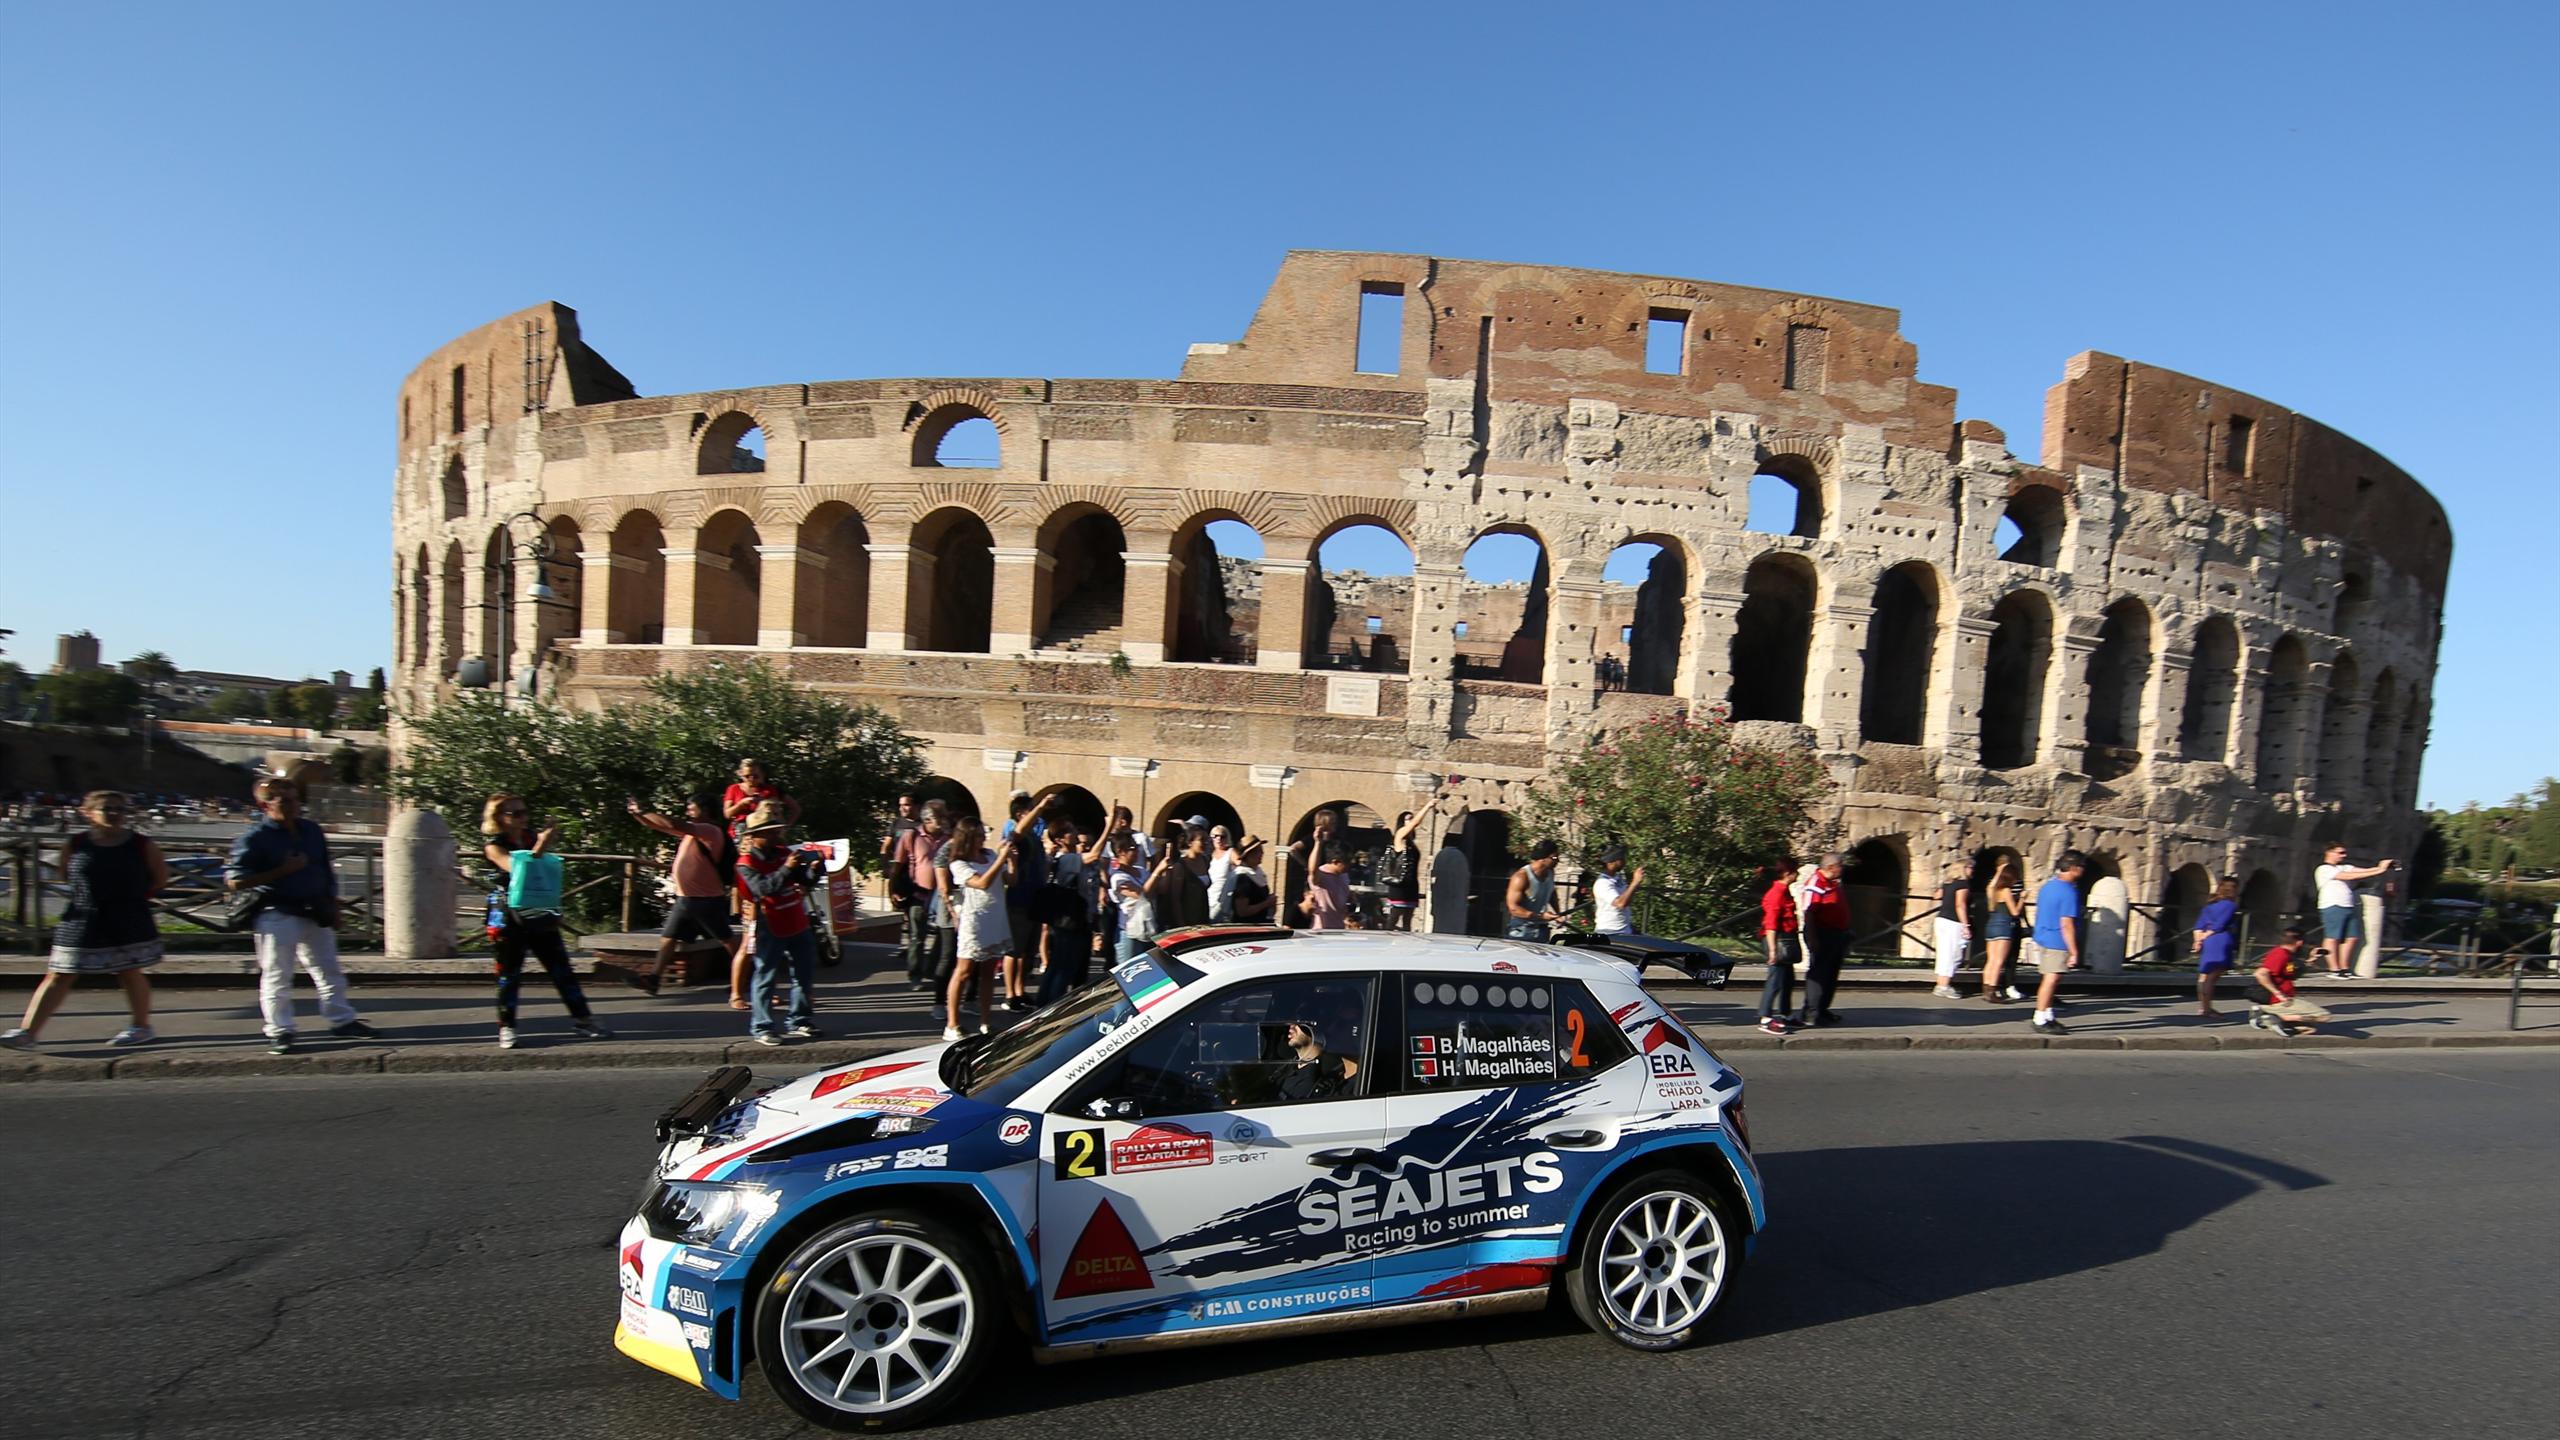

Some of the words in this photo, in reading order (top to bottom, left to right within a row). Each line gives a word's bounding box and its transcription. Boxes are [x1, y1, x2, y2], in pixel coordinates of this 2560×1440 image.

[1065, 1015, 1153, 1080] www.bekind.pt
[1440, 1037, 1458, 1054] B.
[1463, 1036, 1551, 1057] Magalhães
[1567, 1009, 1590, 1067] 2
[1442, 1060, 1460, 1076] H.
[1465, 1058, 1553, 1078] Magalhães
[1650, 1054, 1695, 1074] ERA
[1659, 1086, 1703, 1098] CHIADO
[1671, 1099, 1701, 1111] LAPA
[1003, 1124, 1029, 1137] DR
[1066, 1131, 1096, 1178] 2
[1117, 1143, 1155, 1154] RALLY
[1173, 1139, 1207, 1149] ROMA
[1136, 1150, 1190, 1162] CAPITALE
[1219, 1152, 1269, 1165] SPORT
[1298, 1152, 1564, 1235] SEAJETS
[1345, 1224, 1416, 1251] Racing
[1422, 1218, 1442, 1235] to
[1448, 1204, 1530, 1230] summer
[1075, 1255, 1137, 1276] DELTA
[1247, 1286, 1371, 1310] CONSTRUÇÕES
